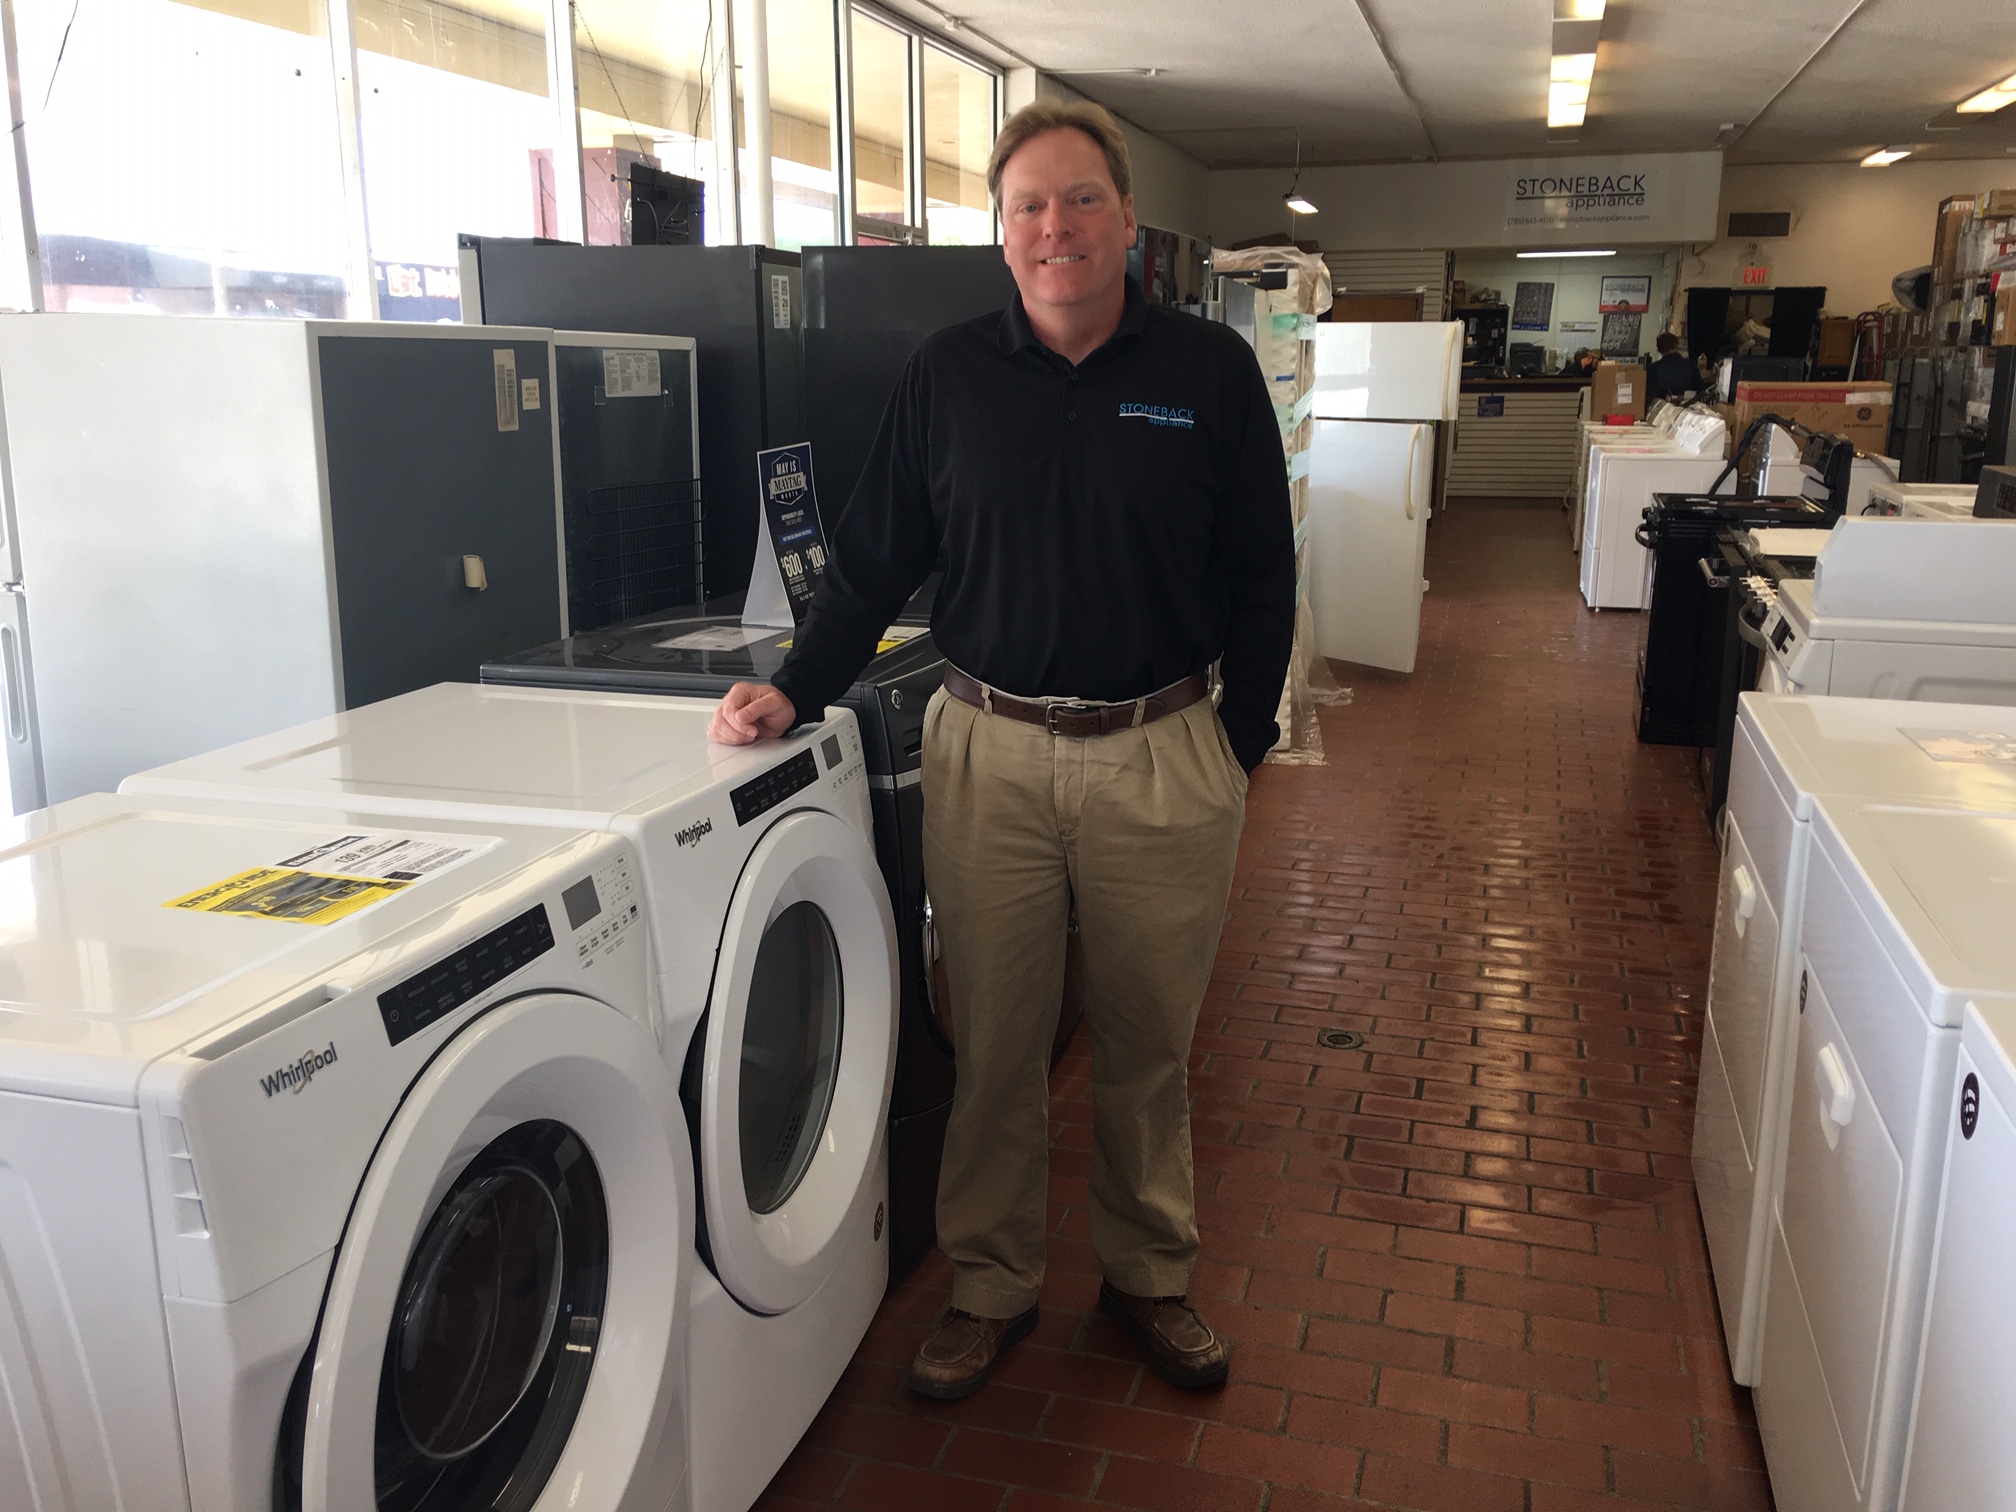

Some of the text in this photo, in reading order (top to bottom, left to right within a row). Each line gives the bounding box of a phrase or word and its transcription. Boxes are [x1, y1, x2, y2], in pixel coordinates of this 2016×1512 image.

[1516, 174, 1646, 196] STONEBACK
[1565, 194, 1645, 210] appliance
[1744, 266, 1768, 285] EXIT
[1119, 403, 1194, 420] STONEBACK
[1148, 417, 1193, 429] appliance
[776, 460, 796, 476] MAY IS
[774, 474, 802, 493] MAYTAG
[780, 552, 803, 578] $600
[806, 545, 825, 569] $100
[675, 817, 713, 847] Whirlpool
[260, 1041, 338, 1098] Whirlpool
